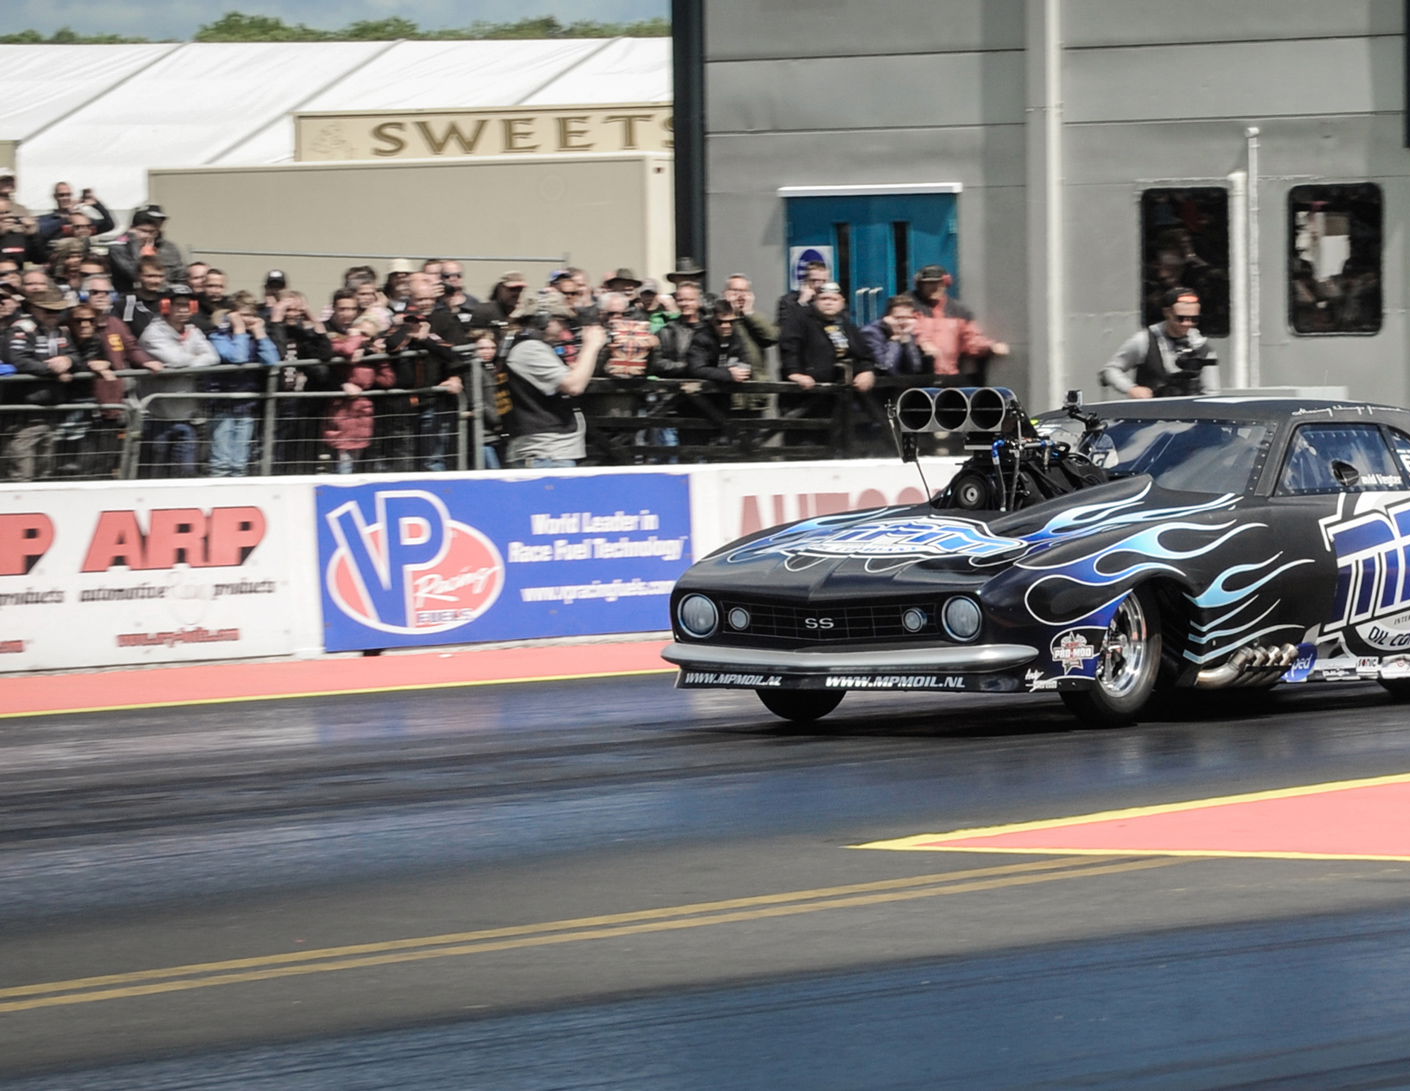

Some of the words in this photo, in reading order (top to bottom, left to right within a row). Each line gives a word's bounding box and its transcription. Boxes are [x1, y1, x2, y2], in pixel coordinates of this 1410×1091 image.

[80, 505, 268, 574] ARP
[325, 489, 452, 629] VP
[805, 617, 835, 629] SS
[1368, 626, 1388, 646] OIL
[824, 675, 966, 689] WWW.MPMOIL.NL
